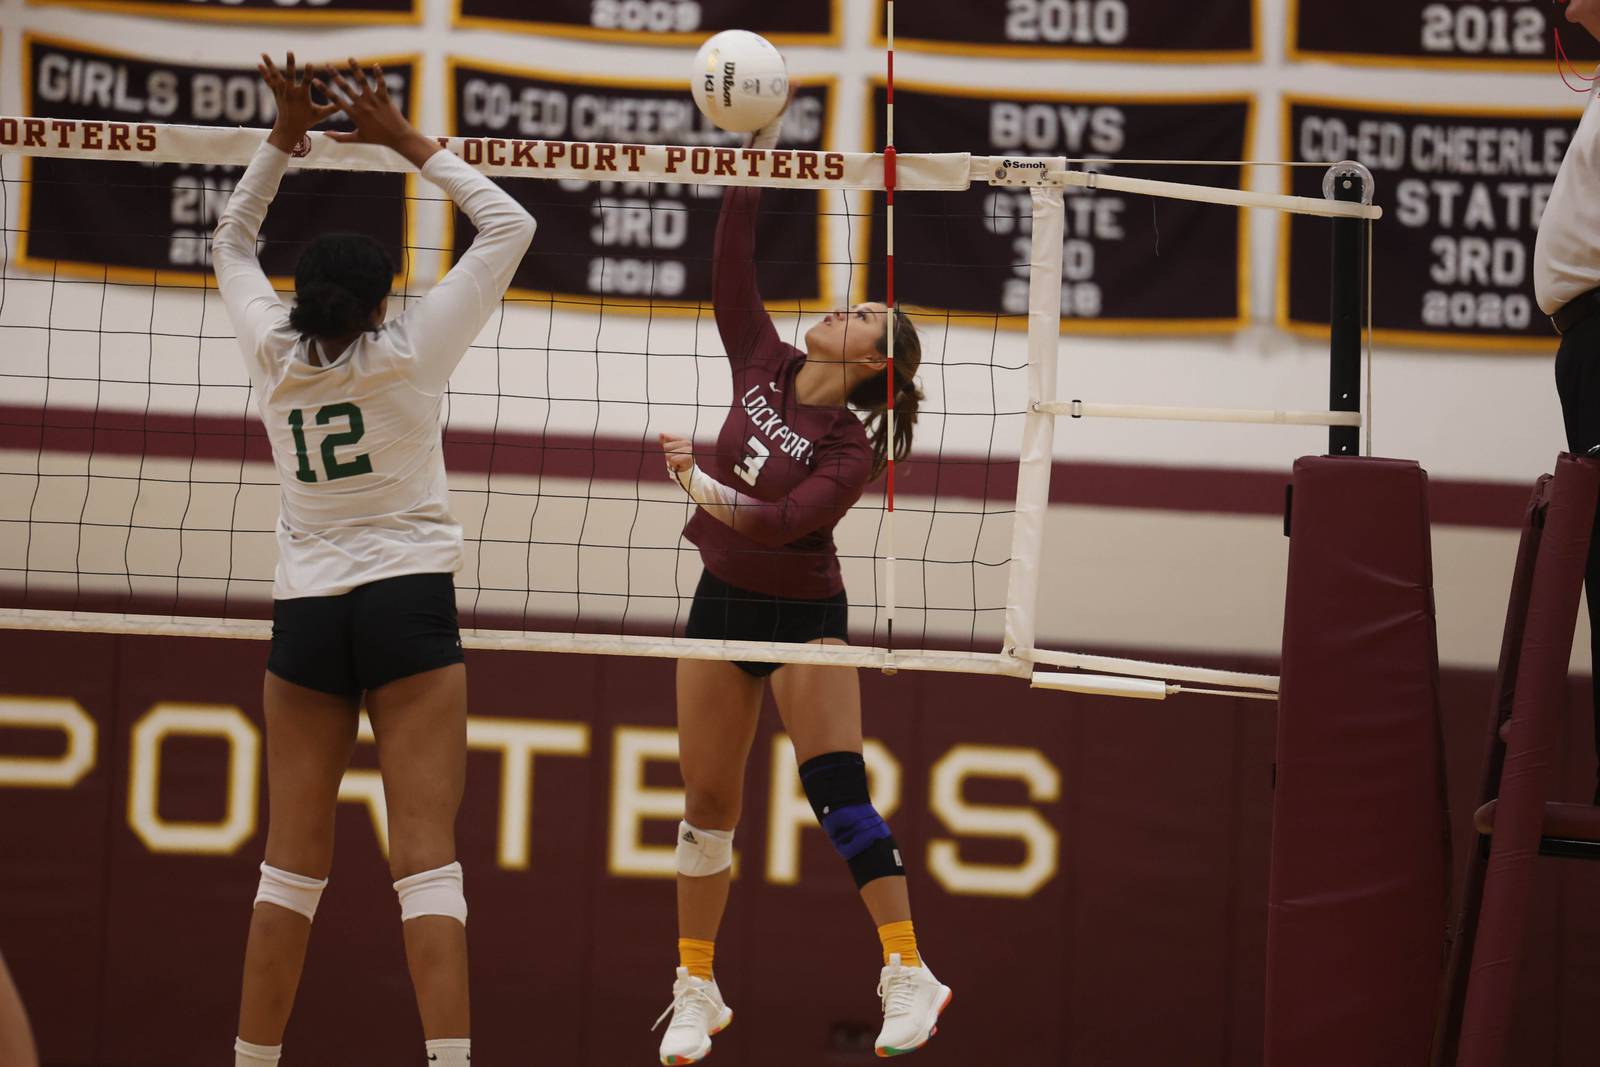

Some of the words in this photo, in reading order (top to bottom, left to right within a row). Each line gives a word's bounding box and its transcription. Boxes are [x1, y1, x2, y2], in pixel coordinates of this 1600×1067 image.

[1006, 0, 1128, 43] 2010
[1421, 5, 1545, 53] 2012
[38, 54, 178, 117] GIRLS
[462, 78, 568, 138] CO-ED
[723, 62, 735, 107] Wilson
[990, 103, 1124, 152] BOYS
[1300, 116, 1405, 169] CO-ED
[665, 146, 845, 180] PORTERS
[1013, 161, 1046, 169] Senoh
[590, 197, 688, 248] 3RD
[984, 192, 1125, 239] STTE
[1011, 237, 1094, 280] 3D
[1430, 235, 1525, 287] 3RD
[1421, 290, 1531, 329] 2020
[288, 402, 373, 482] 12
[733, 435, 770, 487] 3
